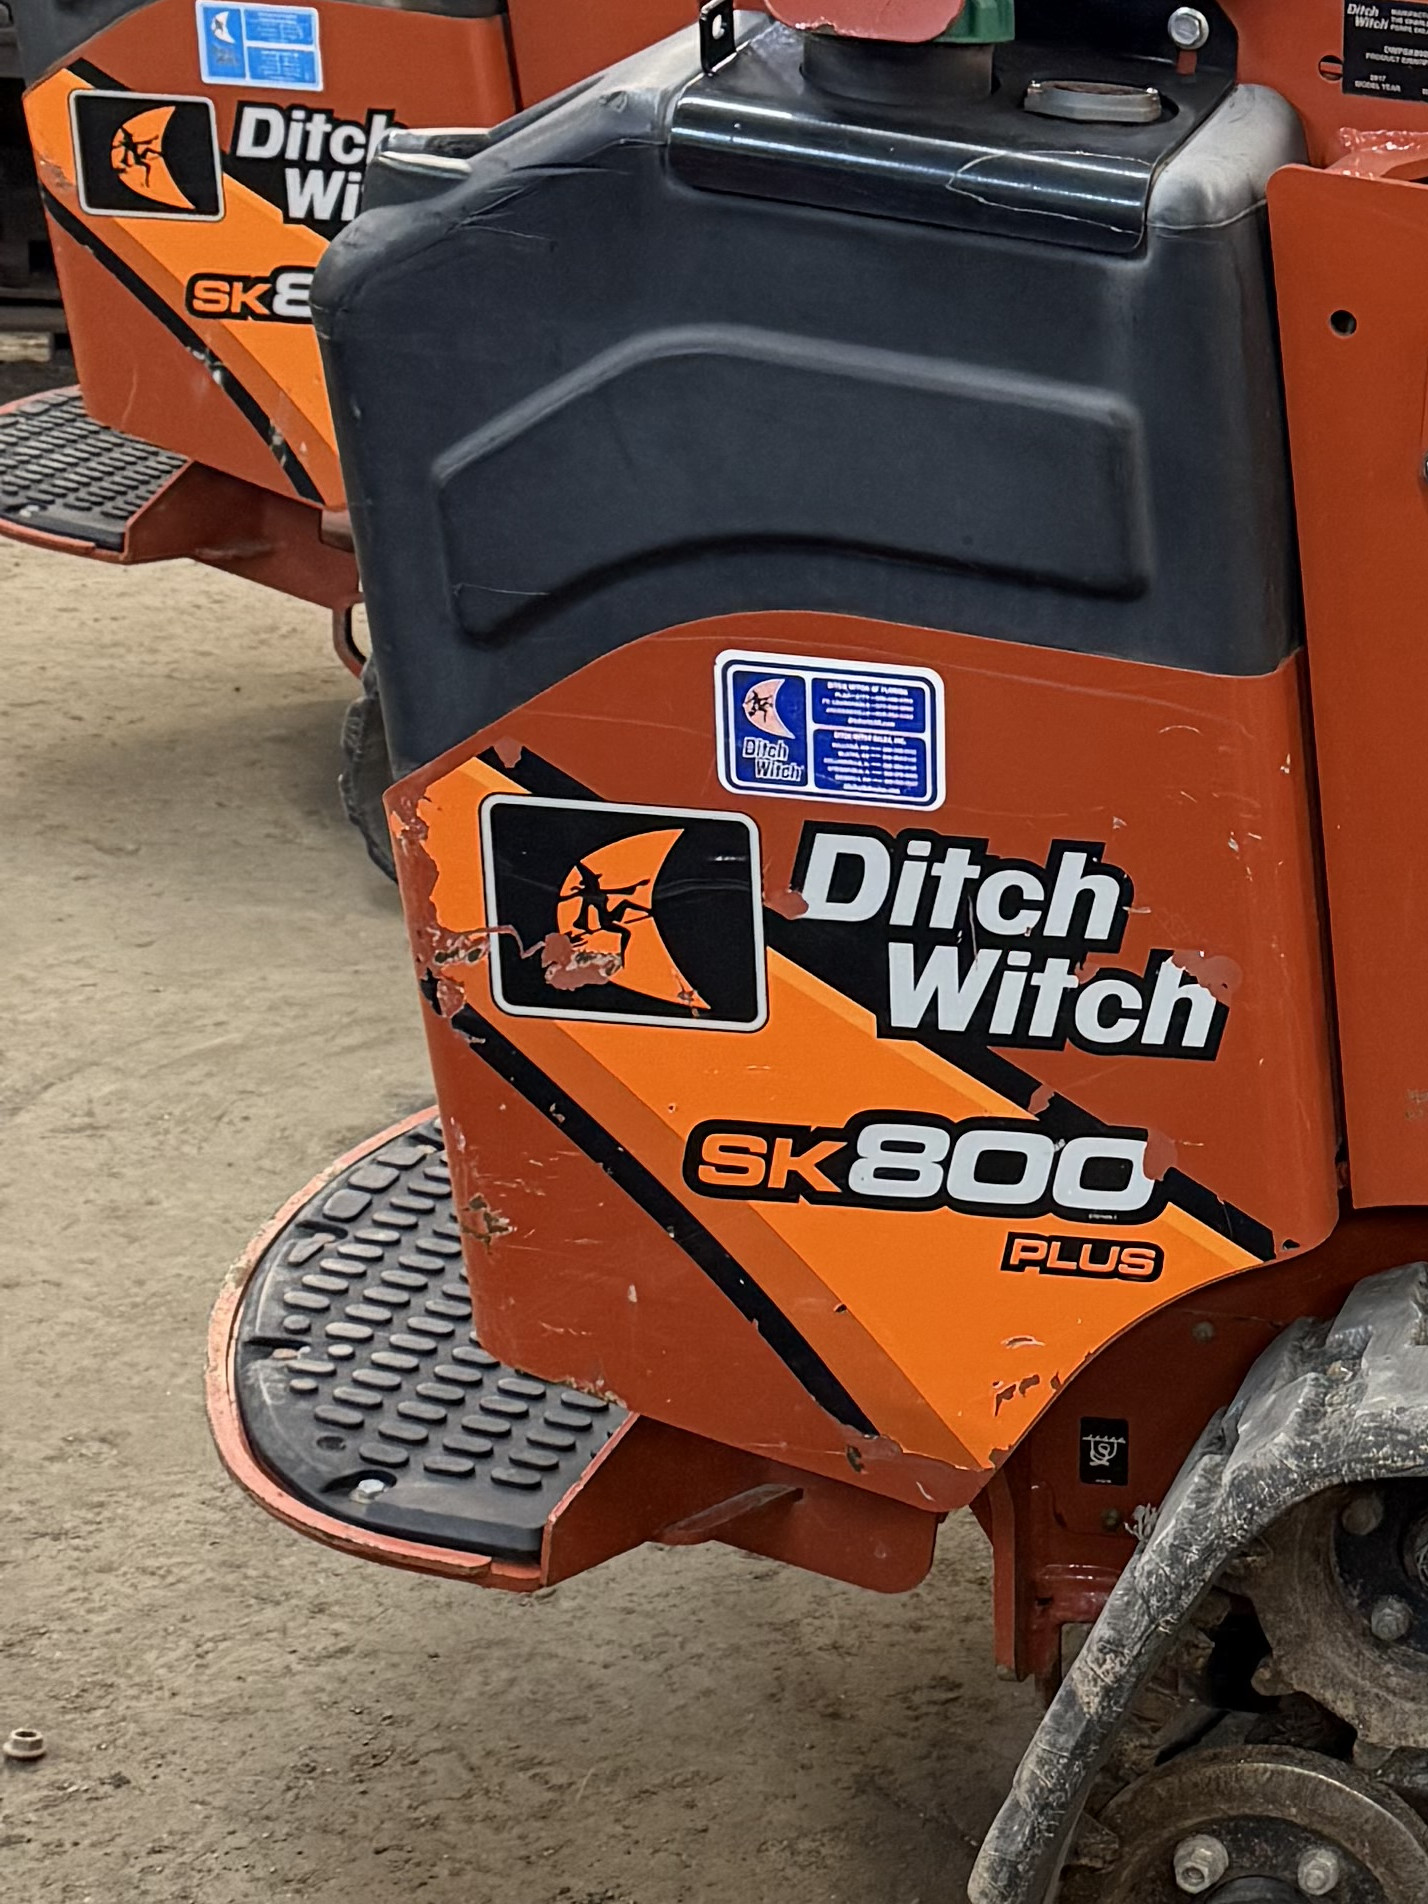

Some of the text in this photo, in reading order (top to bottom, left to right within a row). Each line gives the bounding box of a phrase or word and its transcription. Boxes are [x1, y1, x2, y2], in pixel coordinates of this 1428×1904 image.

[192, 272, 315, 318] SK8
[743, 737, 788, 761] Ditch
[755, 758, 804, 782] Witch
[801, 833, 1123, 940] Ditch
[888, 942, 1220, 1049] Witch
[697, 1122, 1155, 1212] SK800
[1009, 1237, 1158, 1278] PLUS
